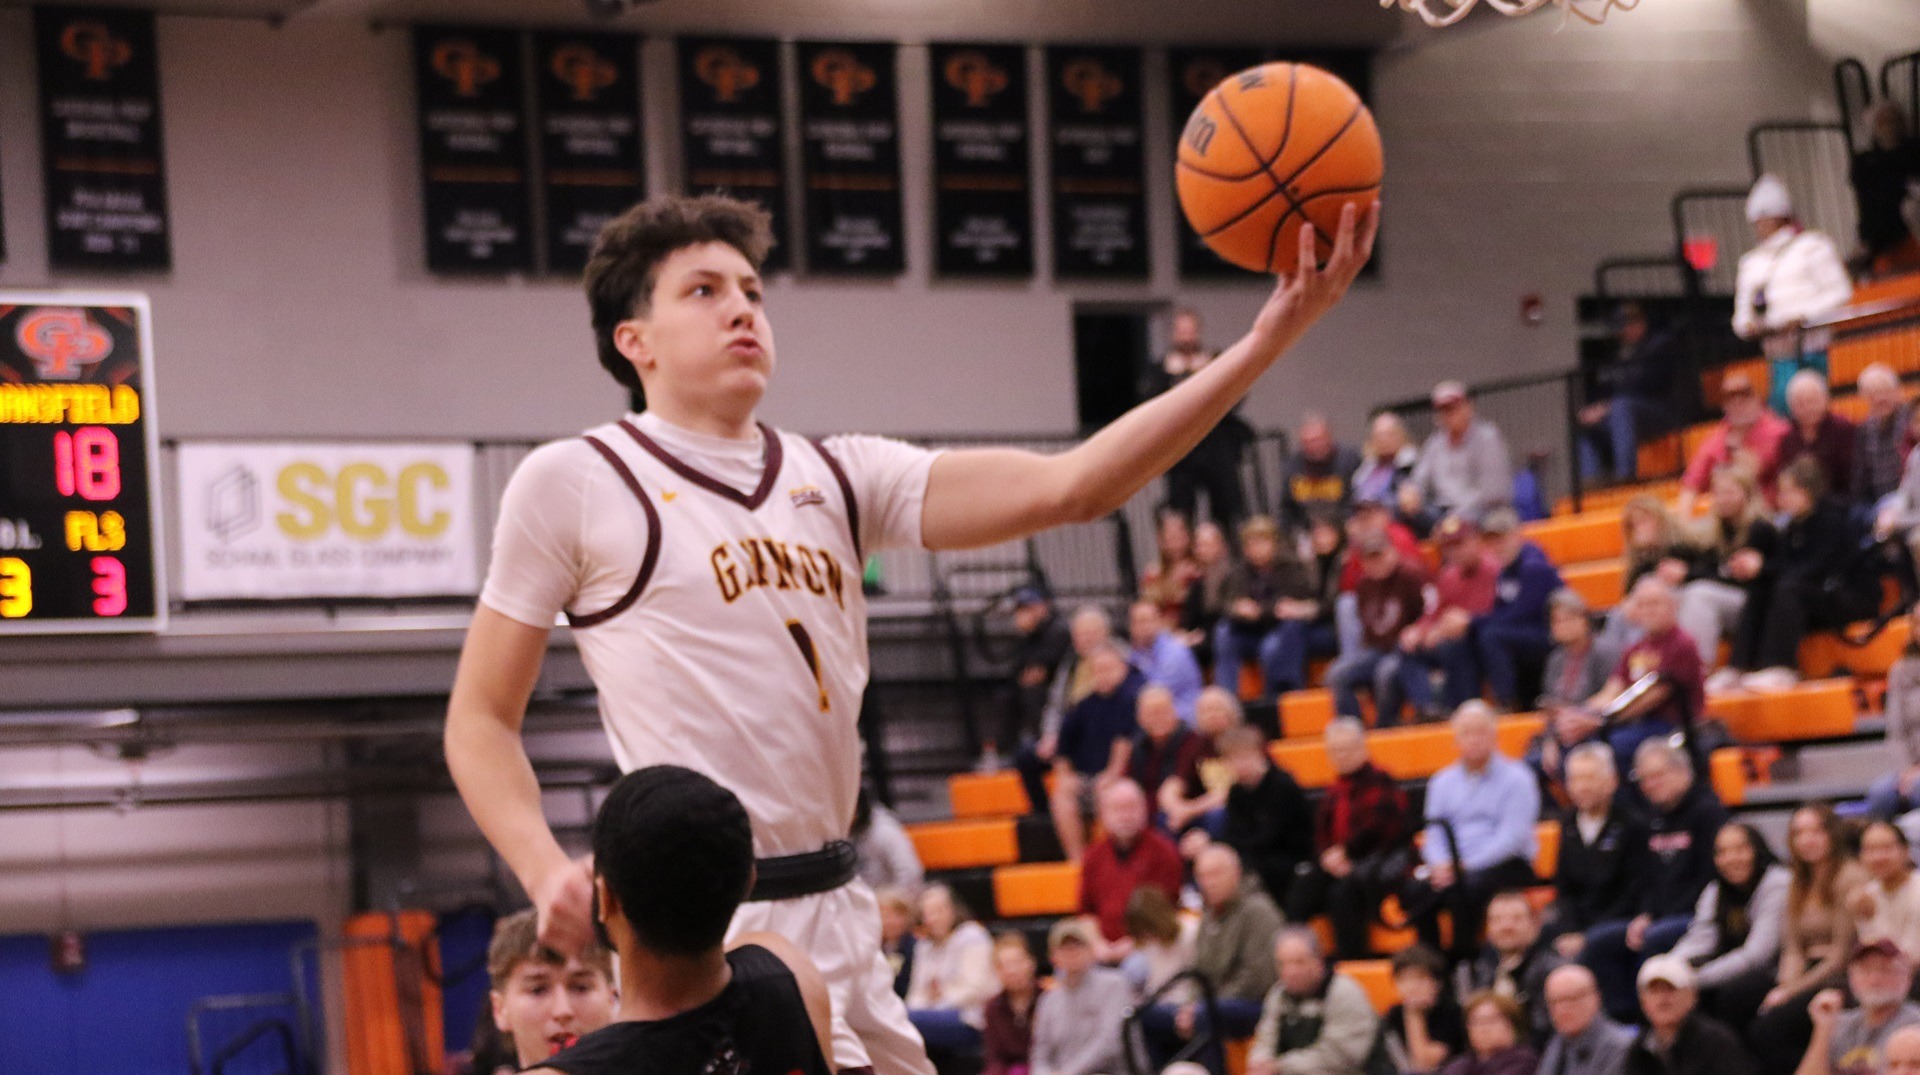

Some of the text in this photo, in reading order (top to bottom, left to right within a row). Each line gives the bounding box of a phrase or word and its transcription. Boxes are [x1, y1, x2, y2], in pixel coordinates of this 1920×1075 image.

[0, 383, 140, 424] ANSFIELD
[54, 427, 121, 501] 18
[276, 462, 451, 540] SGC
[0, 556, 33, 618] 3
[90, 556, 128, 617] 3
[786, 618, 830, 713] 1
